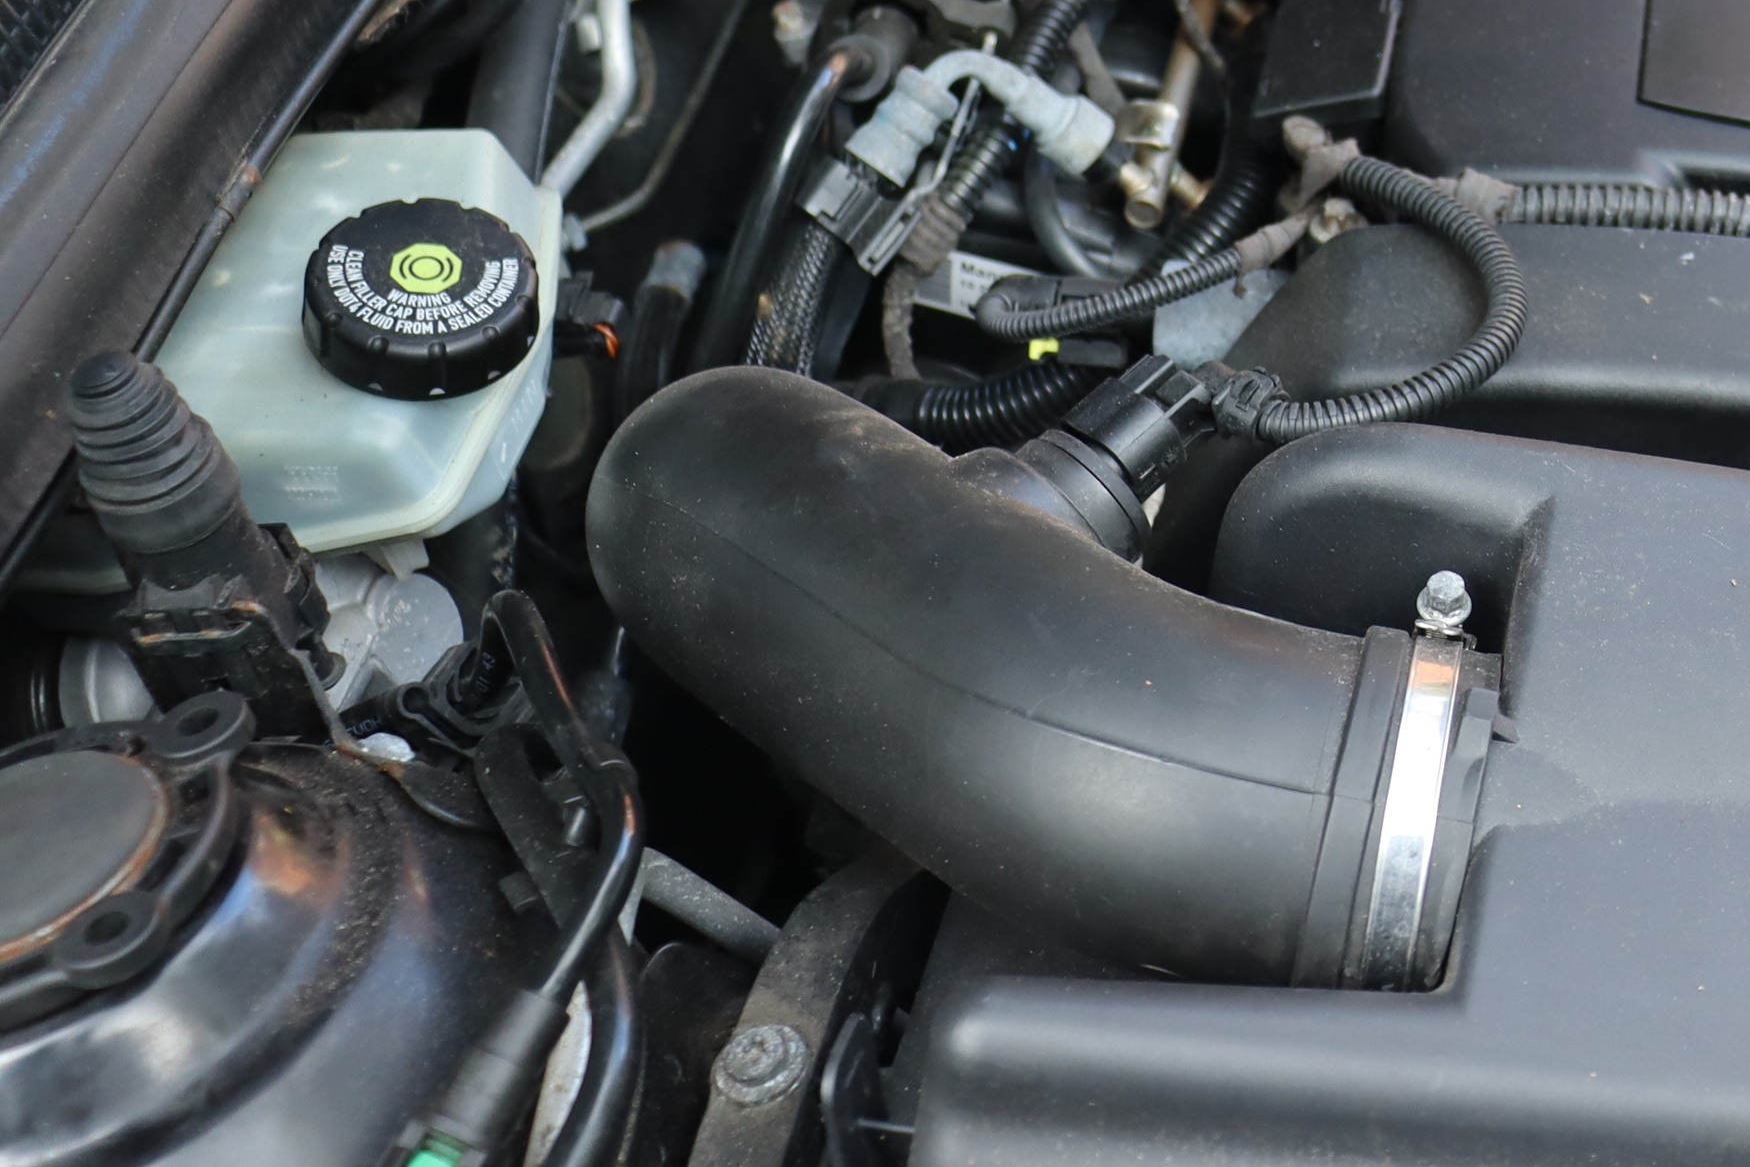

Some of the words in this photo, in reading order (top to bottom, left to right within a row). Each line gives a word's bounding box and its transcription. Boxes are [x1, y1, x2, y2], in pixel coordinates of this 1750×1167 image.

[328, 244, 348, 263] USE
[327, 264, 348, 287] ONLY
[345, 250, 364, 282] CLEAN
[463, 261, 500, 308] REMOVING
[487, 258, 519, 307] CONTAINER
[351, 281, 387, 311] FILLER
[387, 288, 451, 307] WARNING
[356, 307, 394, 330] FLUID
[386, 304, 413, 319] CAP
[416, 300, 468, 320] BEFORE
[448, 303, 494, 330] SEALED
[395, 320, 434, 334] FROM
[438, 320, 447, 333] A
